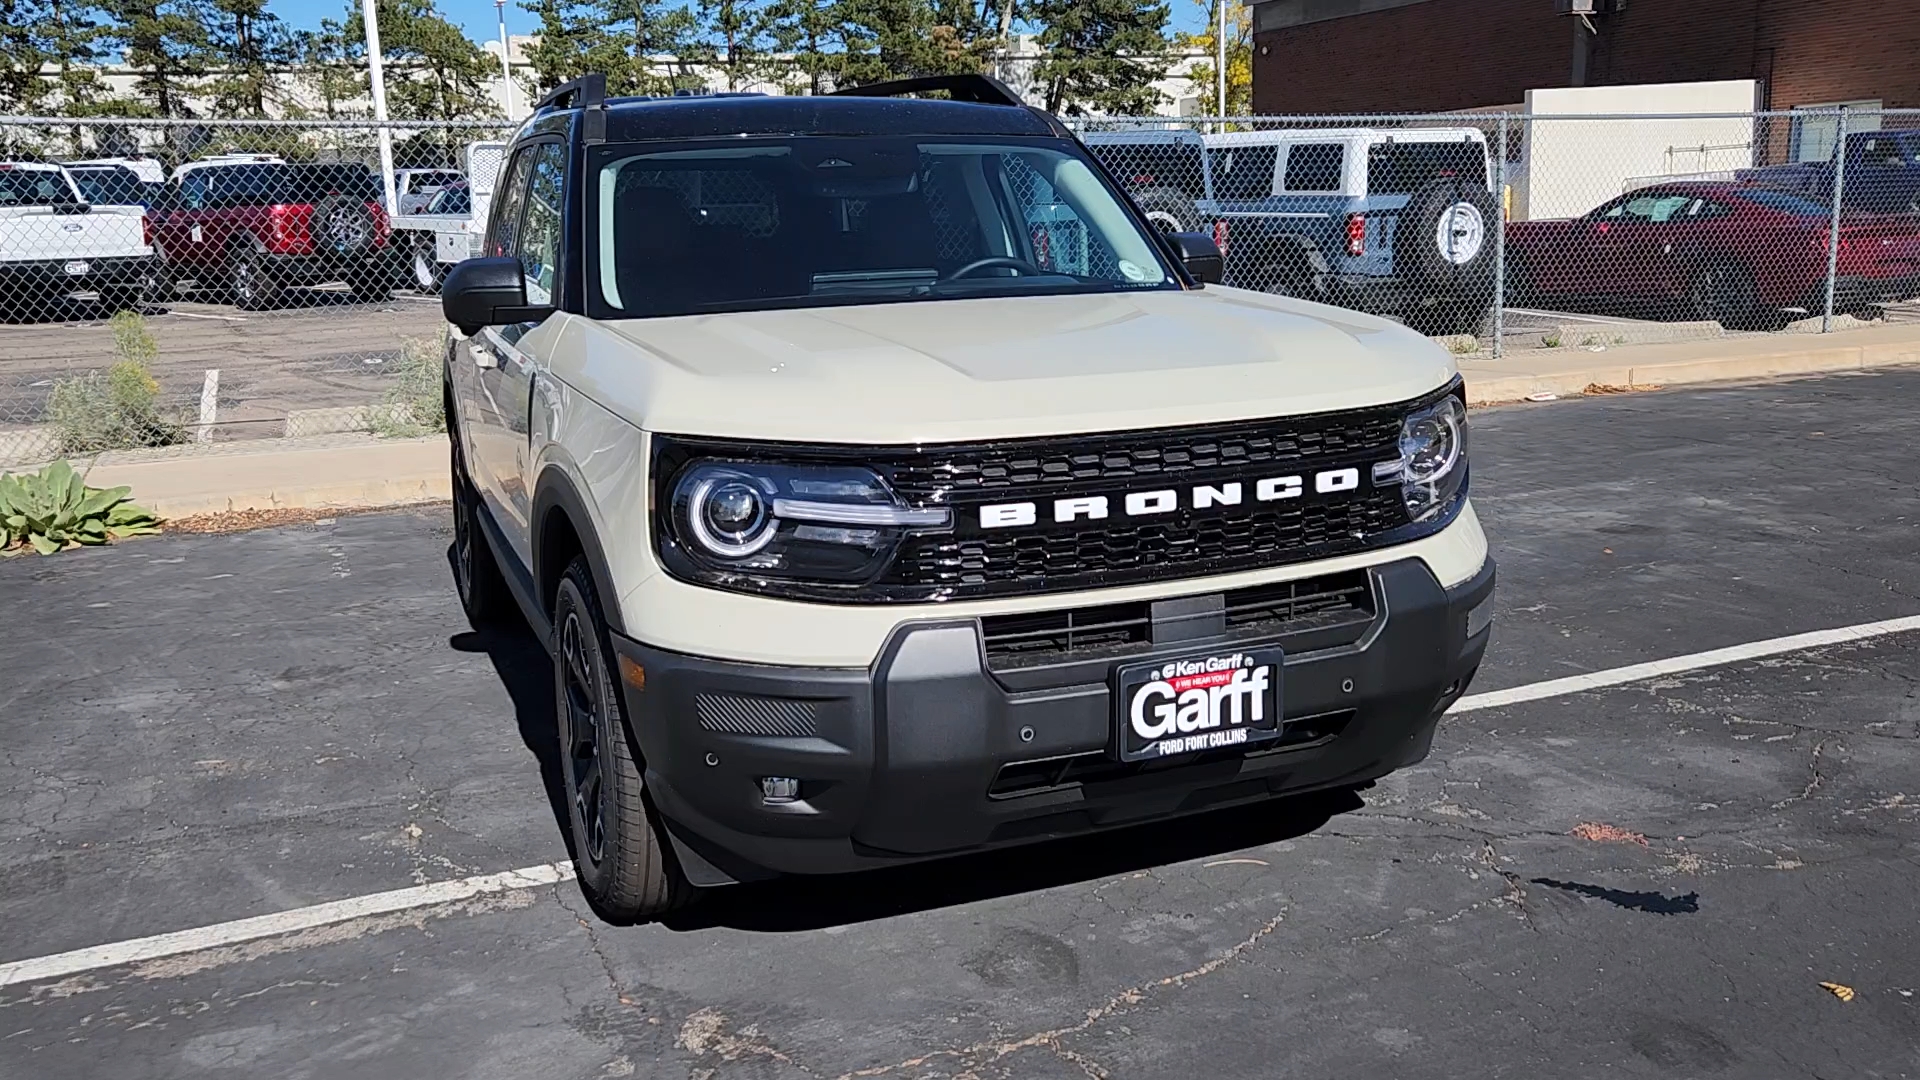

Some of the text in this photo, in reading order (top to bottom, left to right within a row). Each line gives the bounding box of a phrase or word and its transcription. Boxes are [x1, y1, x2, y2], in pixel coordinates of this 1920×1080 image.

[979, 467, 1360, 529] BRONCO
[1176, 660, 1206, 677] Ken
[1205, 653, 1243, 672] Garff
[1180, 674, 1226, 688] WE HEAR YOU
[1130, 665, 1269, 739] Garff
[1160, 729, 1248, 756] FORD FORT COLLINS
